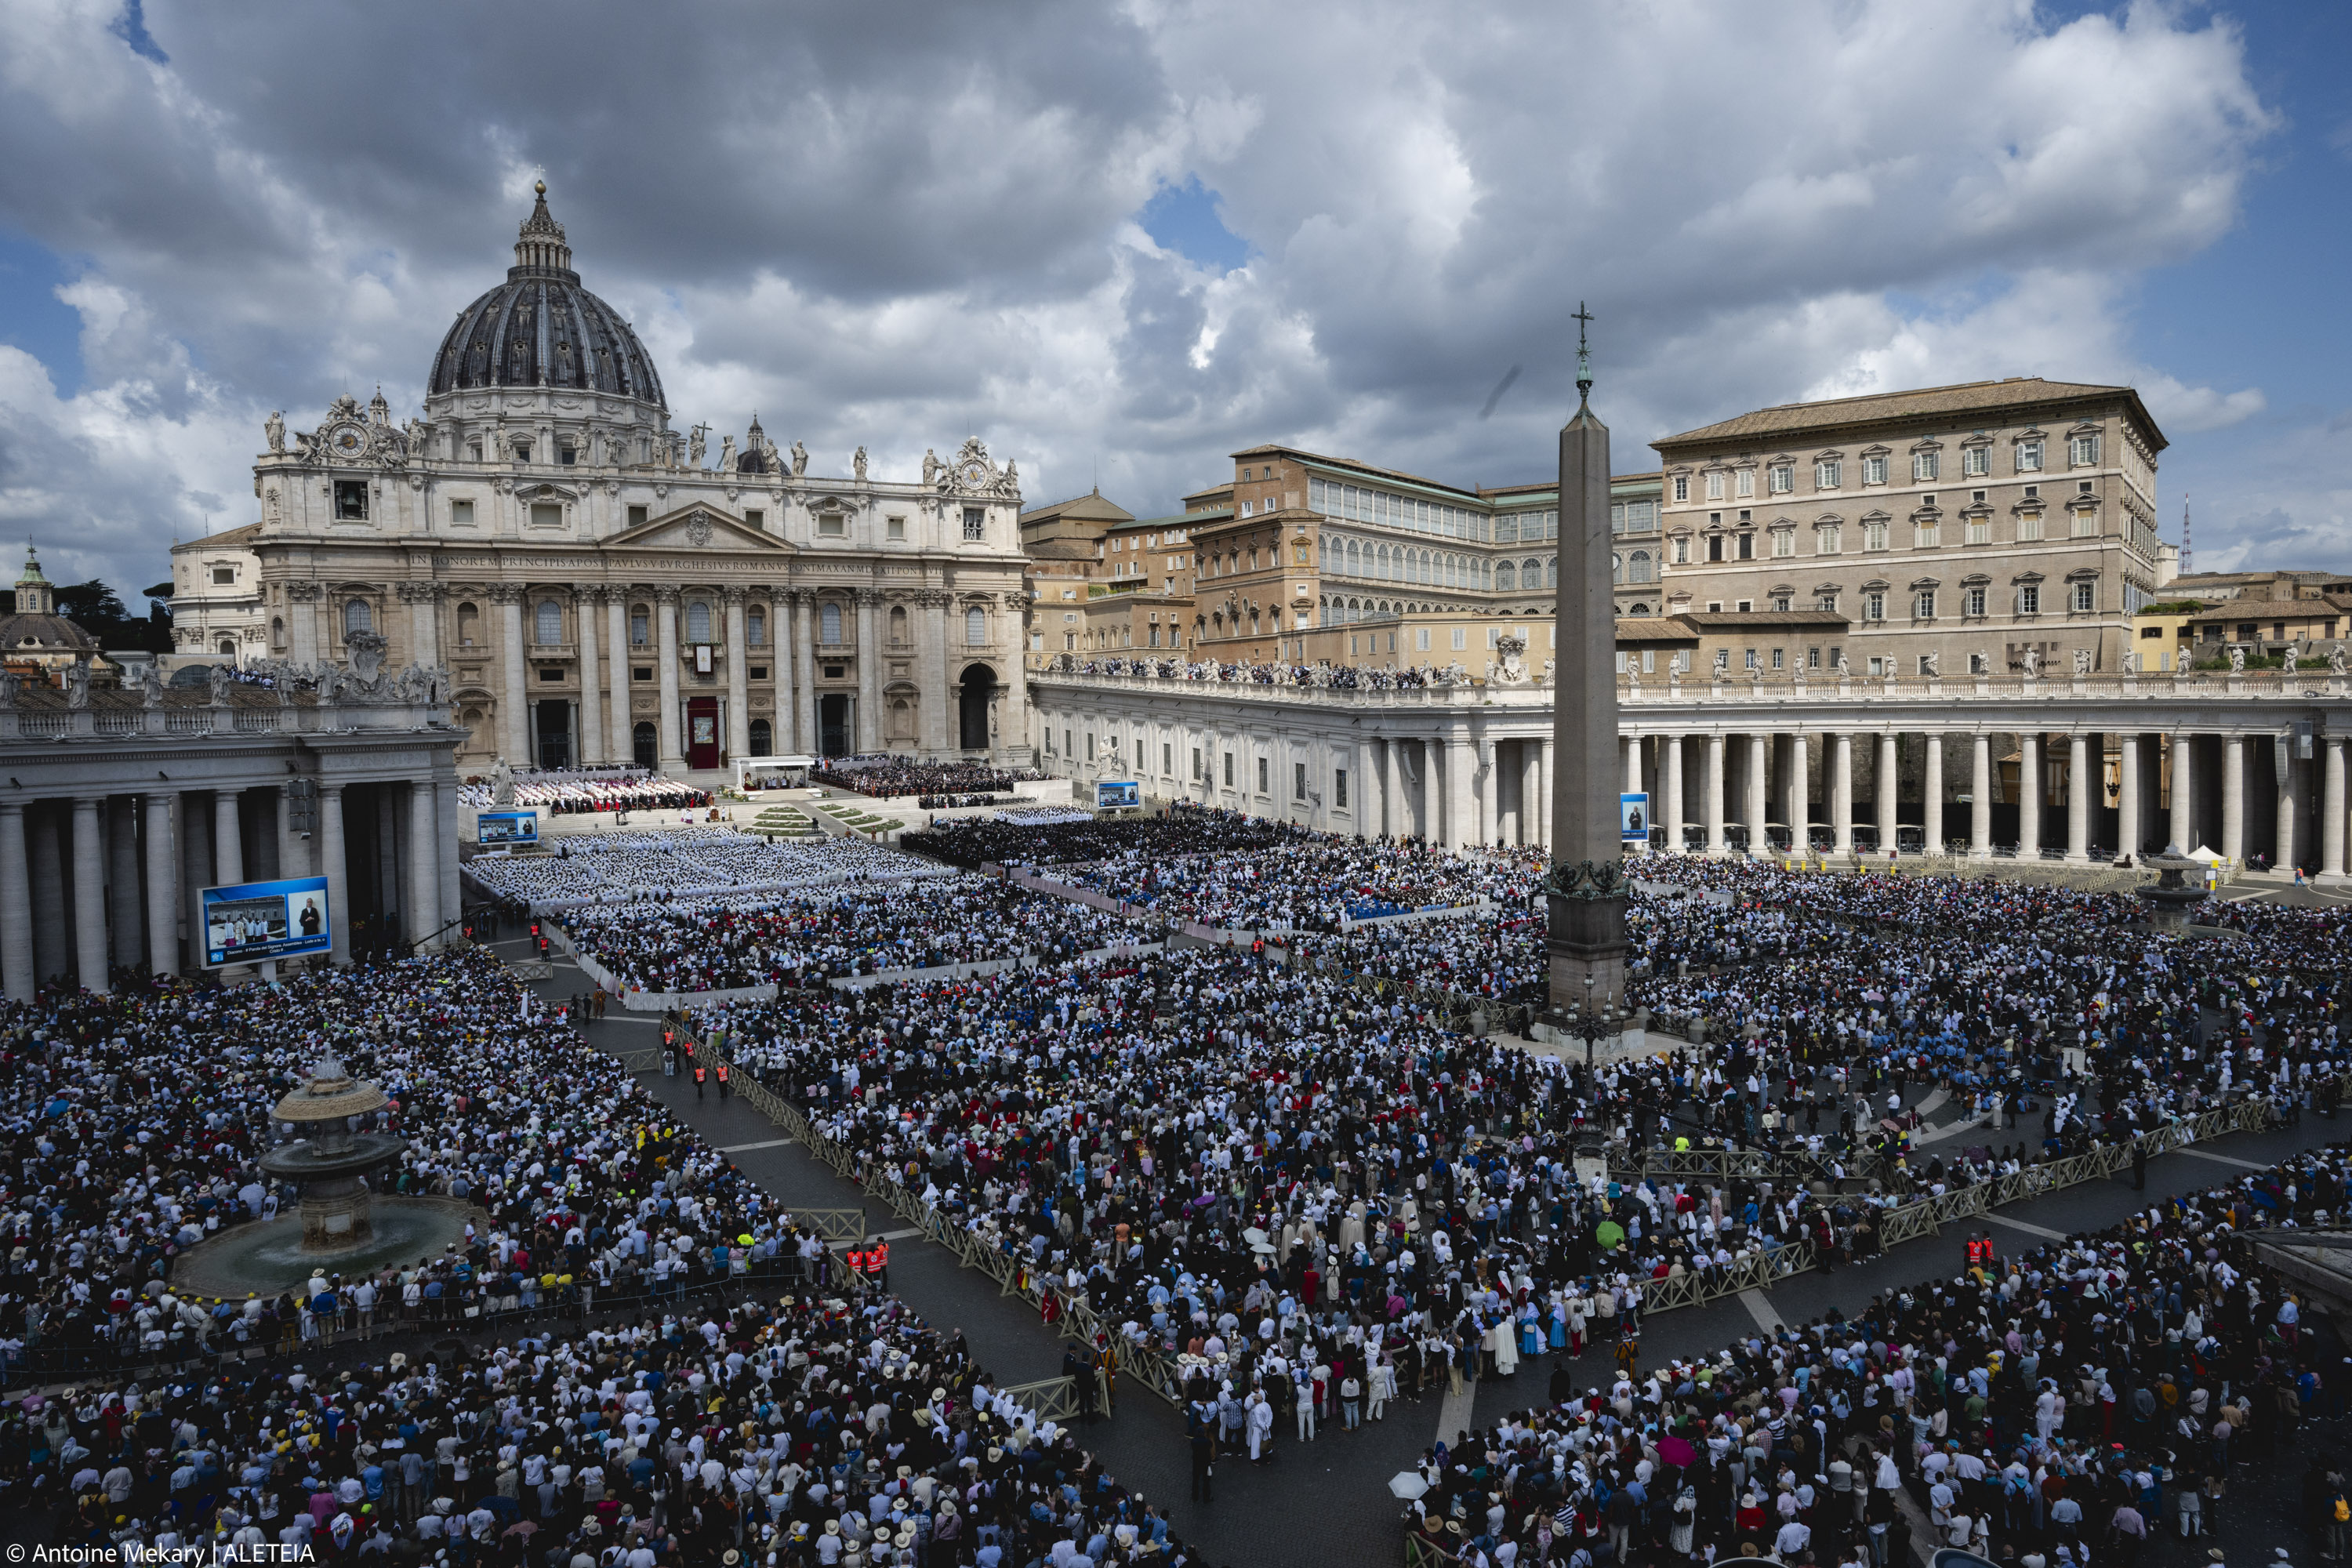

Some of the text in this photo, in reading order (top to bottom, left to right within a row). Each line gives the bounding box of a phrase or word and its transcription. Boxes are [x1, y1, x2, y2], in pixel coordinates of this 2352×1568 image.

[412, 554, 426, 564] IN
[431, 556, 498, 566] HONOREM
[502, 557, 566, 567] PRINCIPIS
[568, 558, 606, 568] APOST
[733, 561, 789, 571] ROMANVS
